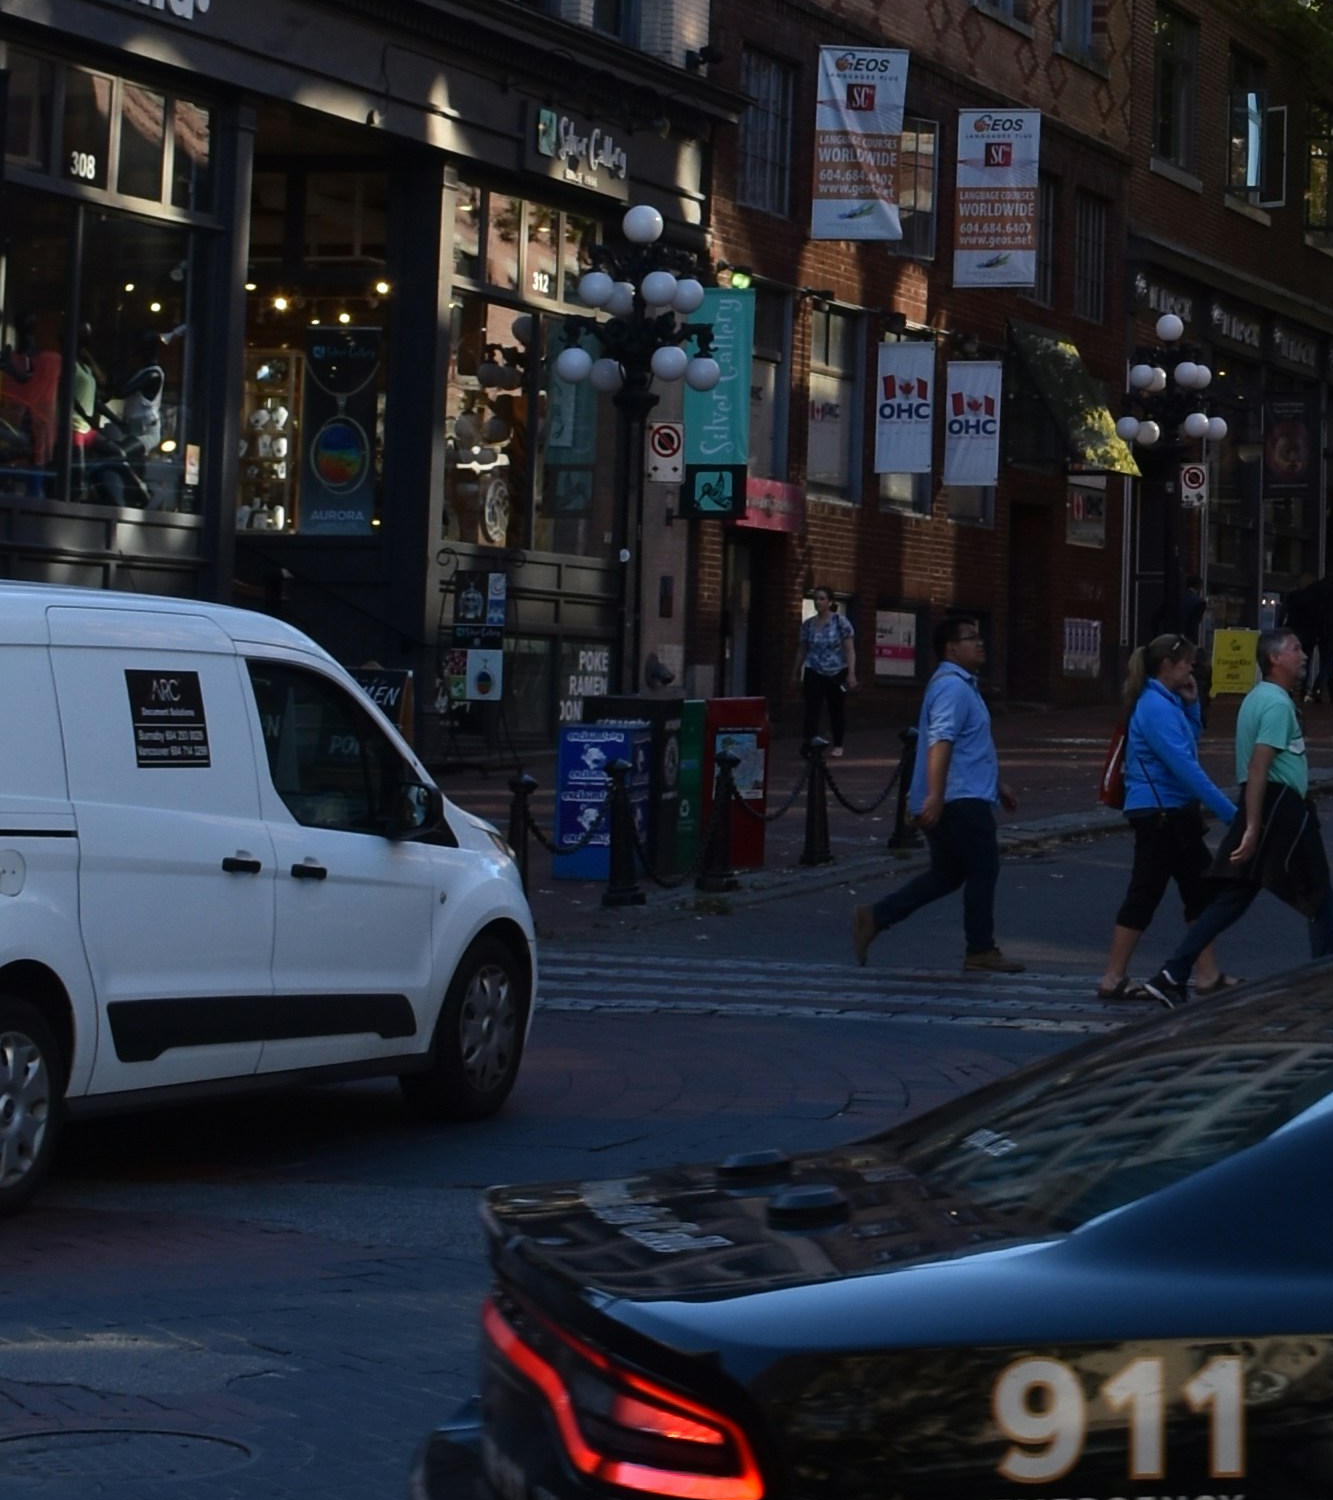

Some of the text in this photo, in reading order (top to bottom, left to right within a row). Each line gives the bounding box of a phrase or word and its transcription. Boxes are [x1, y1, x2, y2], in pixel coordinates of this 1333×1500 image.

[835, 52, 890, 73] GEOS
[973, 114, 1024, 132] GEOS
[69, 150, 96, 181] 308
[818, 146, 897, 168] WORLDWIDE
[959, 190, 1035, 201] LANGUAGE COURSES
[958, 202, 1035, 217] WORLDWIDE
[531, 271, 549, 293] 312
[700, 384, 734, 456] Silver
[879, 402, 931, 420] OHC
[947, 418, 998, 436] OHC
[310, 510, 364, 522] AURORA
[579, 650, 609, 673] POKE
[151, 678, 181, 702] ARC
[569, 674, 609, 697] RAMEN
[991, 1352, 1247, 1485] 911
